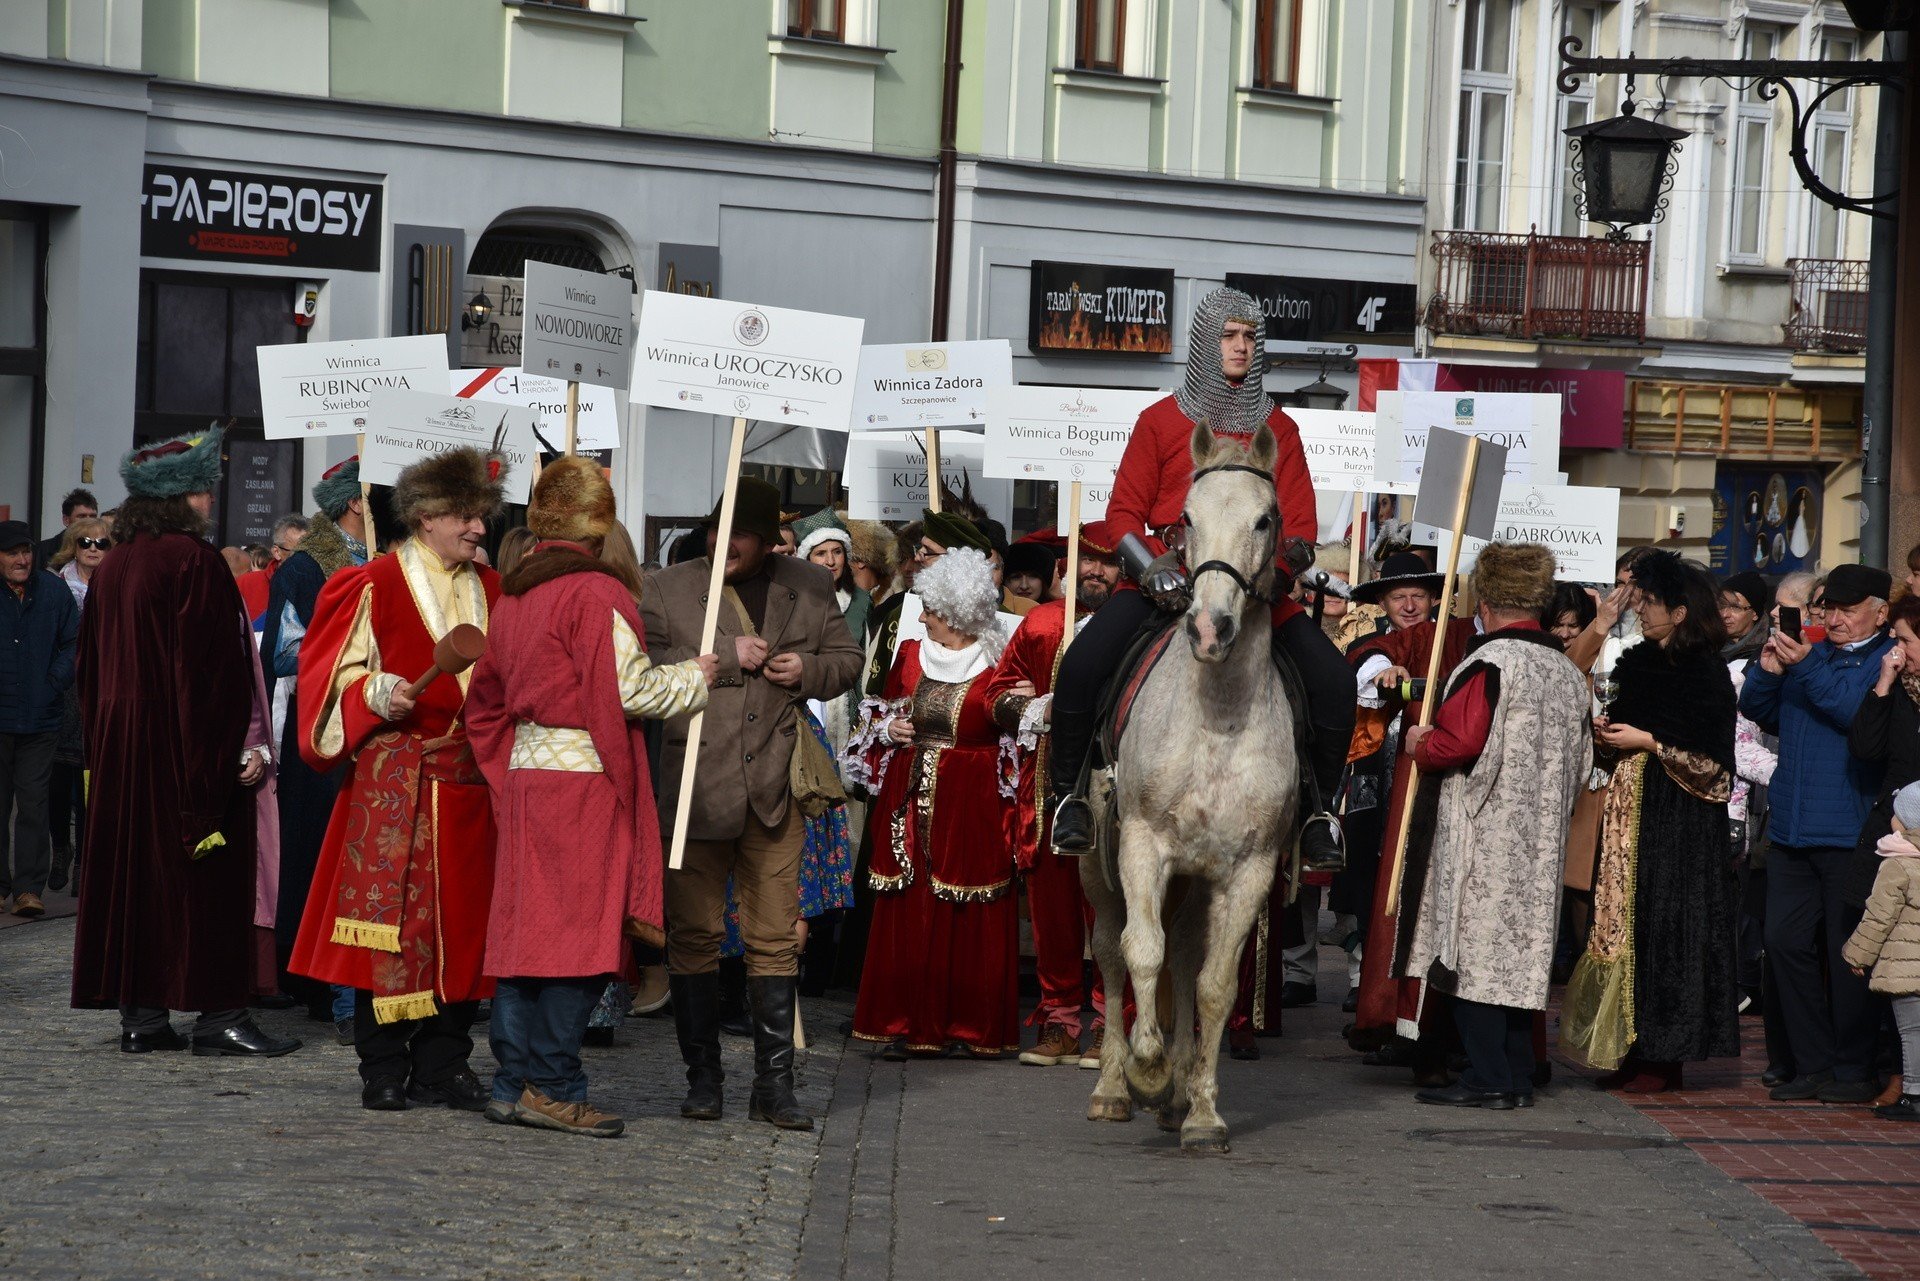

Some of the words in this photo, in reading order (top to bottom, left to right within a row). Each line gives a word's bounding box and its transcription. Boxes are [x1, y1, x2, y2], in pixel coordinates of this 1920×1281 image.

[565, 286, 597, 306] Winnica
[1104, 286, 1167, 325] KUMPIR
[1356, 296, 1387, 332] 4F
[535, 313, 623, 346] NOWODWORZE
[326, 356, 381, 369] Winnica
[647, 346, 709, 368] Winnica
[714, 352, 843, 386] UROCZYSKO
[717, 374, 770, 391] Janowice
[873, 378, 931, 392] Winnica
[935, 376, 983, 390] Zadora
[901, 395, 957, 406] Szczepanowice
[1008, 426, 1061, 439] Winnica
[375, 434, 414, 449] Winnica
[1060, 446, 1094, 458] Olesno
[1303, 443, 1325, 455] AD
[1328, 444, 1369, 460] STARĄ
[252, 456, 269, 466] MODY
[1344, 461, 1373, 473] Burzyn
[245, 480, 275, 490] ZASILANIA
[245, 527, 271, 537] PREMIXY
[1506, 525, 1603, 546] DĄBRÓWKA
